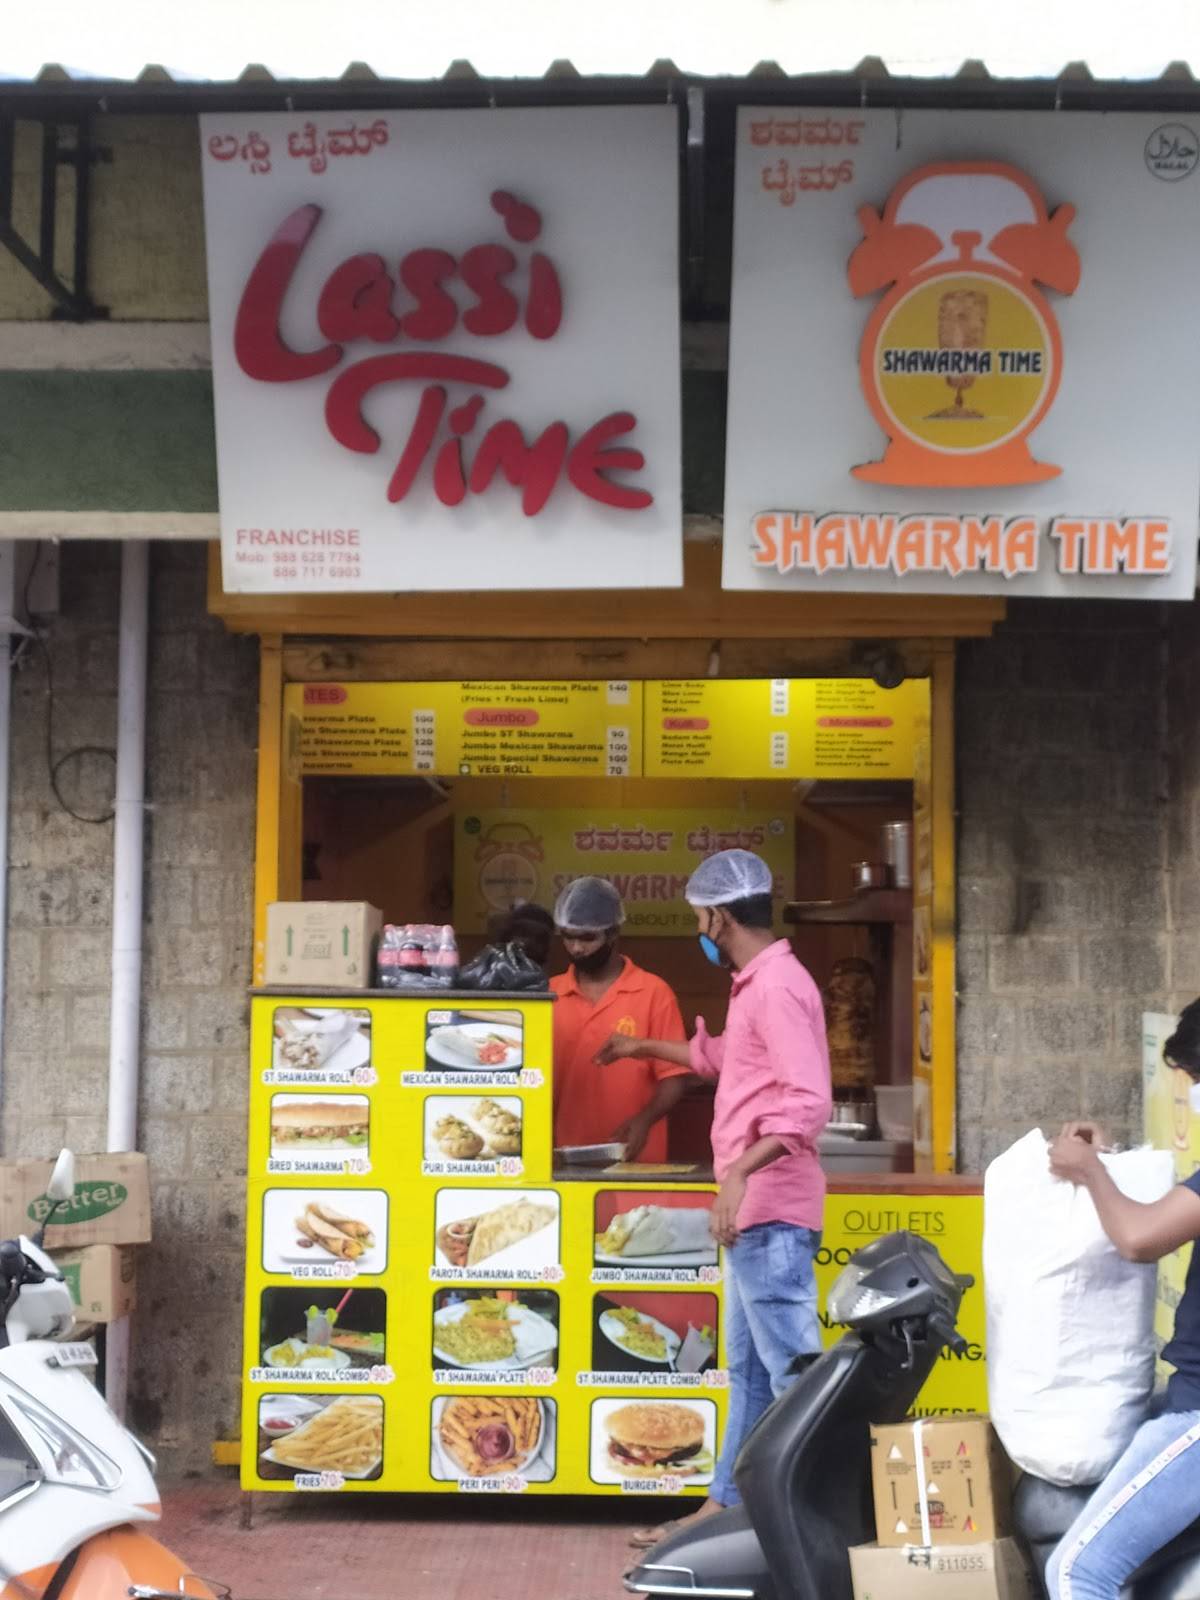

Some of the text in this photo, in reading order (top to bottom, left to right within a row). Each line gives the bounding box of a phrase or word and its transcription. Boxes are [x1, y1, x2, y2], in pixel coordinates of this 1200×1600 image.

[288, 120, 389, 174] ಟೈಮ್
[762, 159, 854, 207] ಟೈಮ್
[234, 189, 563, 382] Lassi
[883, 351, 1041, 373] SHAWARMA TIME
[236, 528, 360, 545] FRANCHISE
[752, 513, 1171, 576] SHAWARMA TIME
[477, 711, 526, 724] Jumbo
[503, 765, 532, 774] ROLL
[264, 1071, 274, 1082] ST
[277, 1072, 326, 1082] SHAWARMA
[329, 1072, 351, 1083] ROLL
[403, 1073, 441, 1084] MEXICAN
[444, 1073, 493, 1084] SHAWARMA
[496, 1073, 517, 1084] ROLL
[269, 1160, 291, 1171] BRED
[295, 1160, 343, 1171] SHAWARMA
[424, 1162, 443, 1173] PURI
[447, 1162, 495, 1173] SHAWARMA
[32, 1184, 119, 1220] Better
[843, 1209, 946, 1233] OUTLETS
[292, 1266, 309, 1276] VEG
[312, 1266, 332, 1277] ROLL
[431, 1268, 463, 1278] PAROTA
[466, 1269, 513, 1279] SHAWARMA
[517, 1270, 537, 1279] ROLL
[592, 1270, 620, 1281] JUMBO
[623, 1270, 672, 1281] SHAWARMA
[675, 1271, 696, 1281] ROLL
[252, 1370, 261, 1380] ST
[265, 1370, 312, 1380] SHAWARMA
[316, 1371, 336, 1380] ROLL
[435, 1371, 445, 1381] ST
[448, 1371, 496, 1382] SHAWARMA
[499, 1372, 525, 1383] PLATE
[578, 1373, 588, 1384] ST
[591, 1373, 639, 1384] SHAWARMA
[642, 1374, 667, 1384] PLATE
[670, 1374, 700, 1385] COMBO
[297, 1477, 320, 1487] FRIES
[461, 1479, 479, 1489] PERI
[481, 1479, 500, 1489] PERI
[624, 1480, 656, 1490] BURGER
